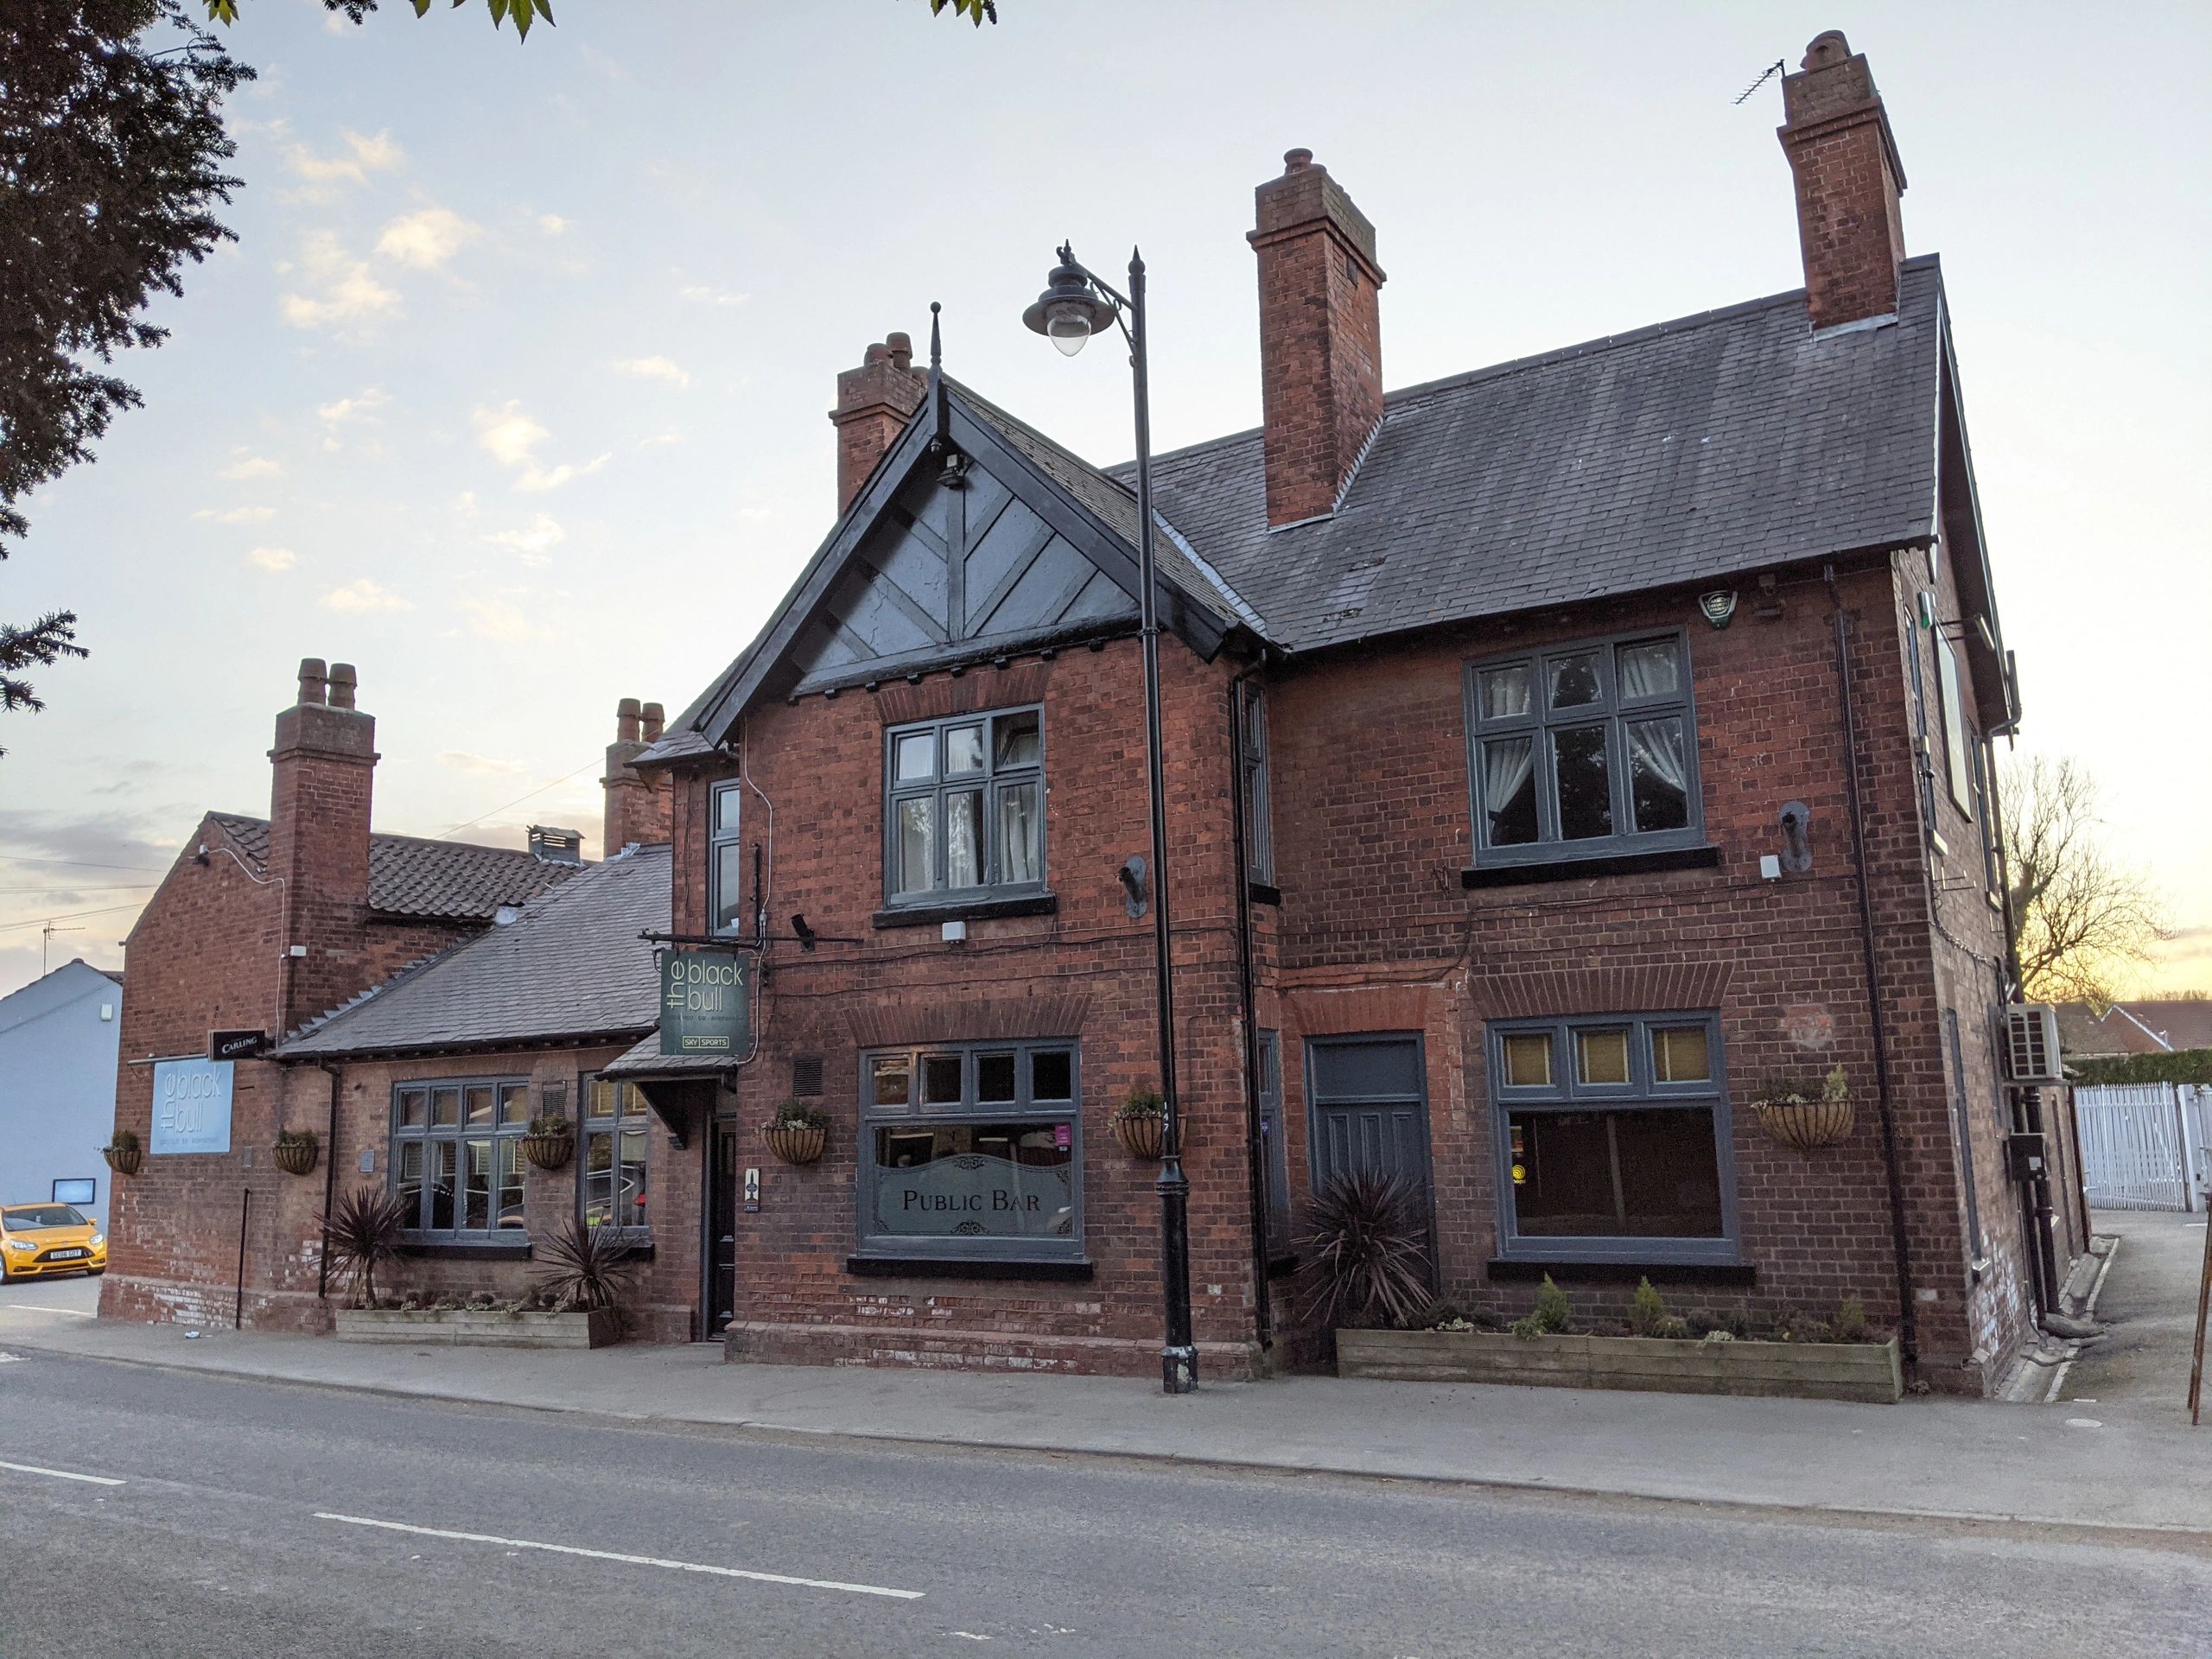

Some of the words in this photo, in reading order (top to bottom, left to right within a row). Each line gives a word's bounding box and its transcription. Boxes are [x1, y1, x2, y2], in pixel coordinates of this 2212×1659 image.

[666, 960, 685, 1009] the
[688, 958, 744, 986] black
[688, 985, 723, 1011] bull
[221, 1036, 257, 1054] CARLING
[176, 1065, 221, 1100] black
[160, 1072, 175, 1133] the
[175, 1101, 204, 1134] bull
[903, 1190, 982, 1211] PUBLIC
[993, 1189, 1041, 1211] BAR
